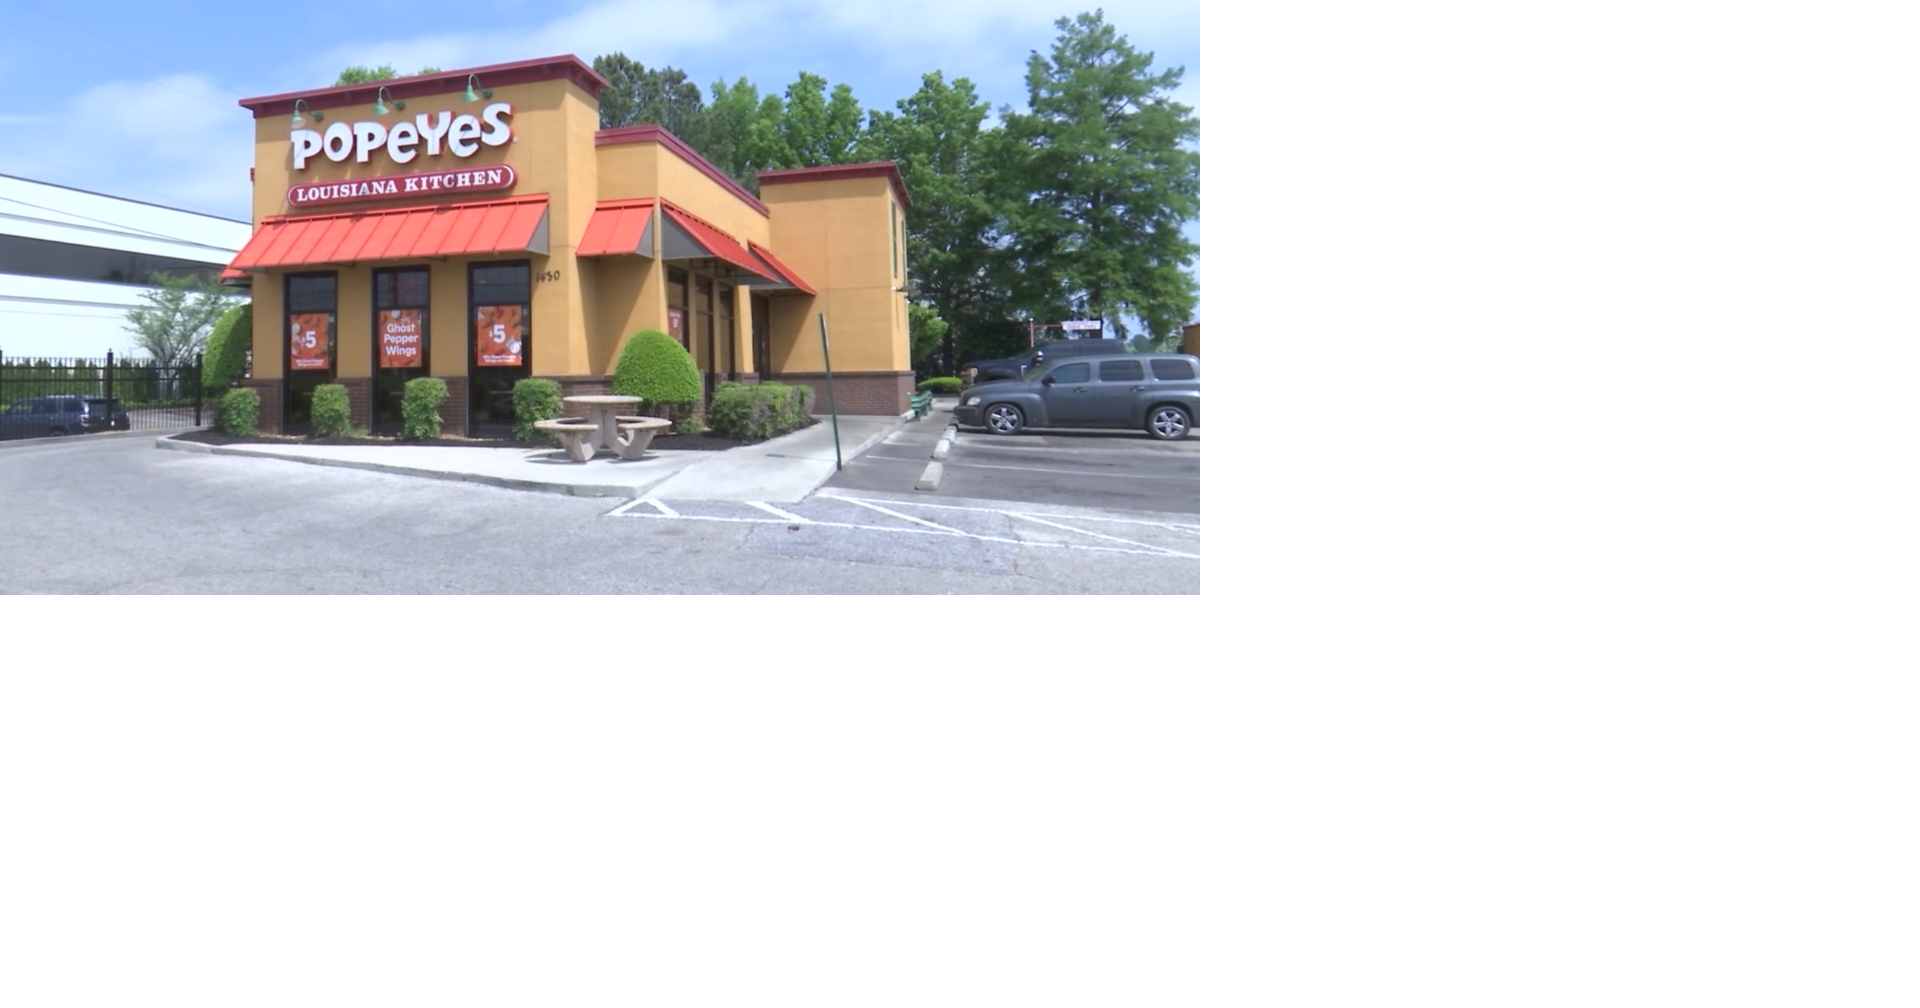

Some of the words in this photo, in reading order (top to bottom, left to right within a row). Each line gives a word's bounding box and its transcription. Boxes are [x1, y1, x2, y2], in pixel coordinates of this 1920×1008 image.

[296, 179, 398, 202] LOUISIANA
[404, 168, 503, 192] KITCHEN
[387, 323, 415, 333] Ghost
[384, 334, 419, 345] Pepper
[386, 345, 417, 357] Wings
